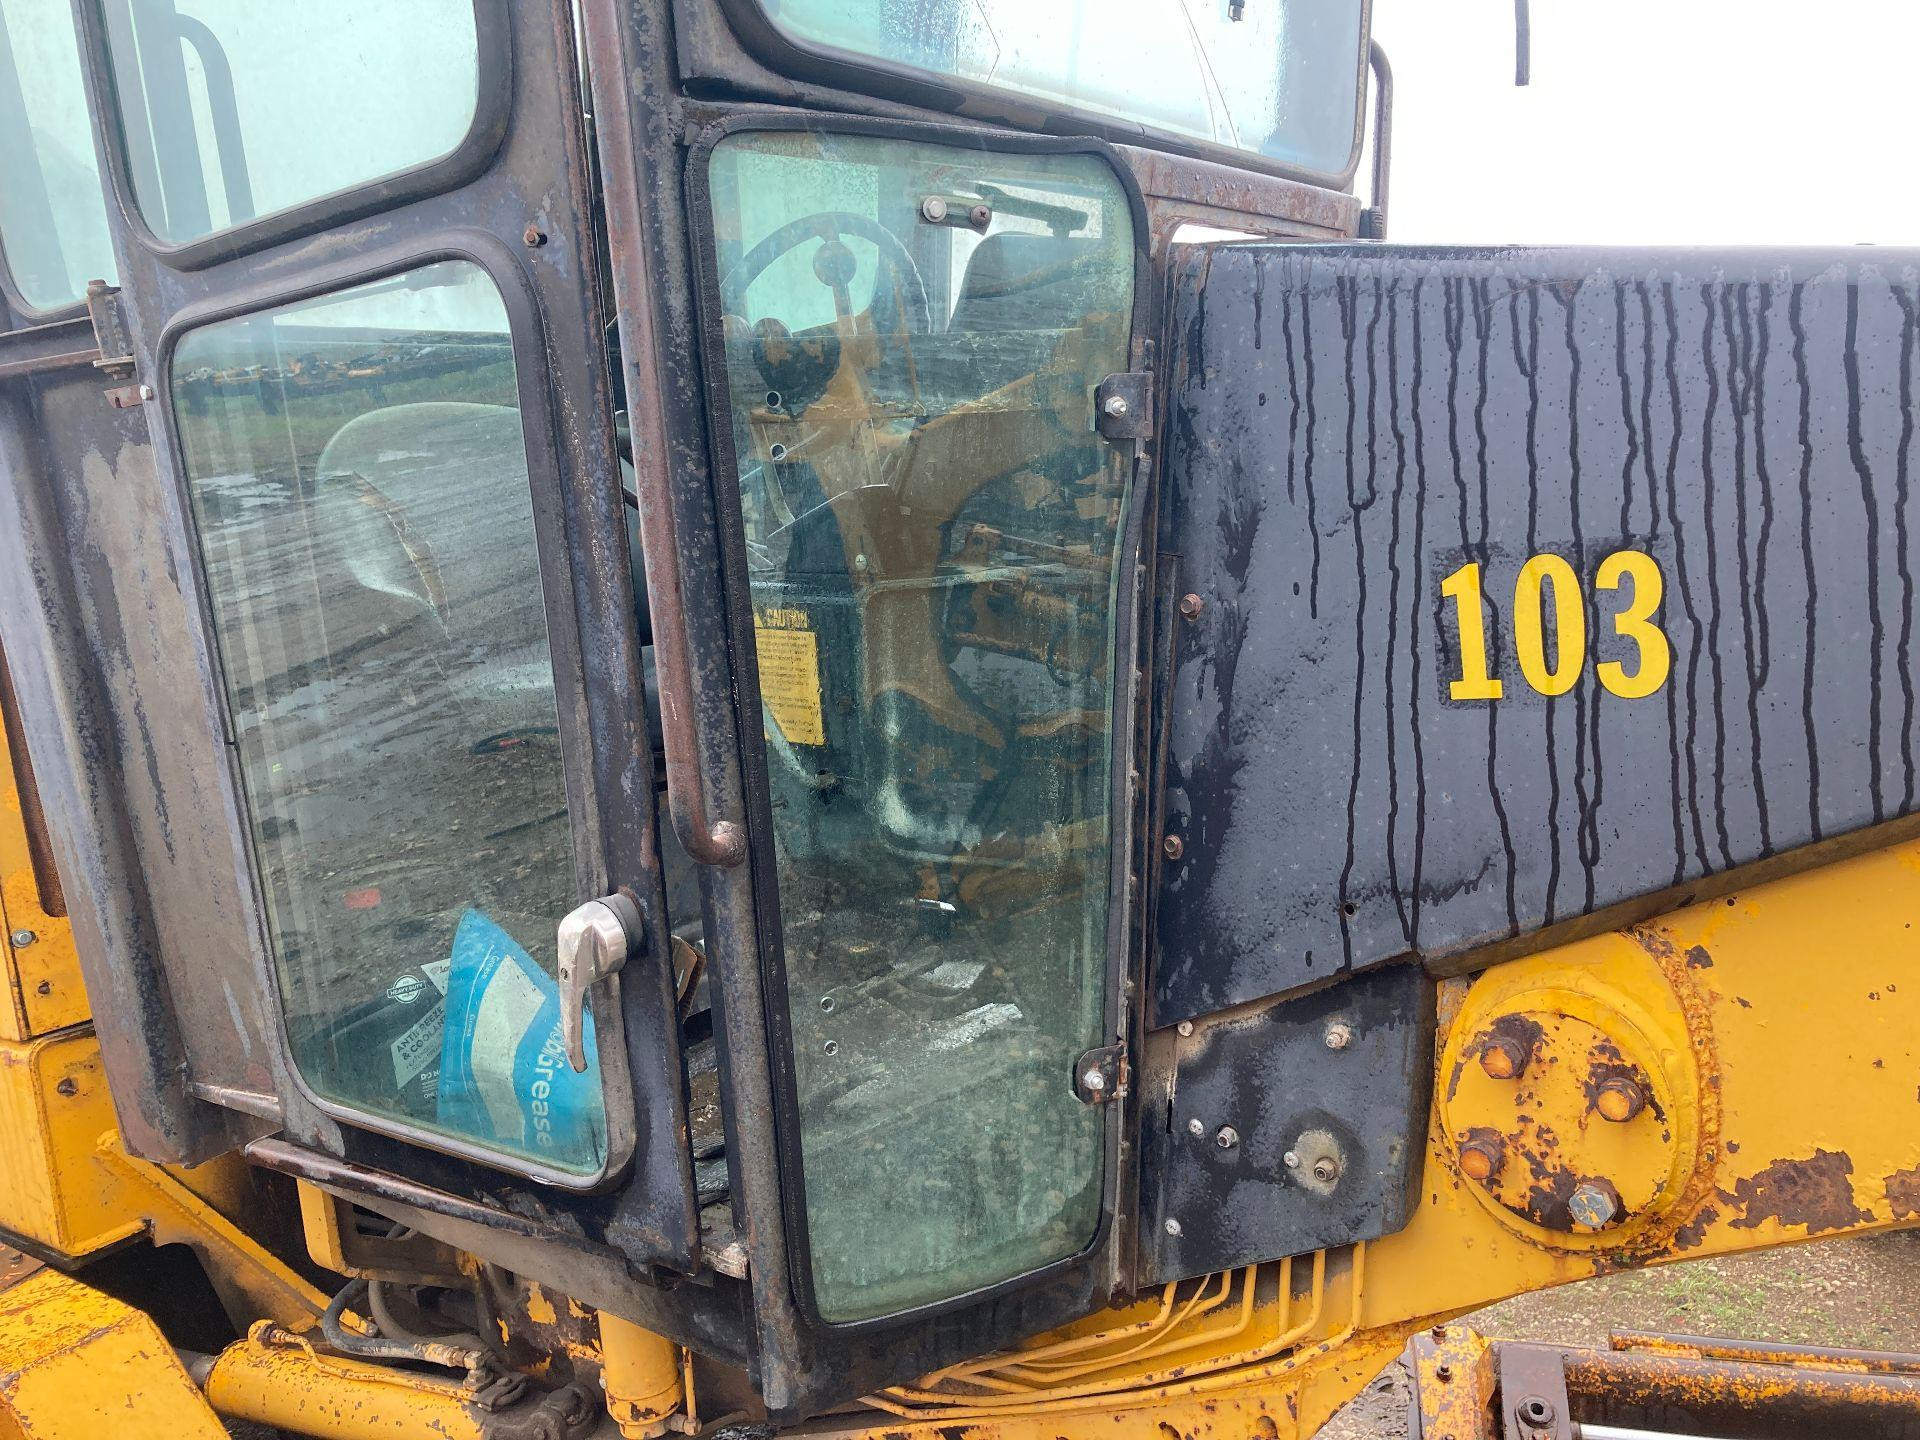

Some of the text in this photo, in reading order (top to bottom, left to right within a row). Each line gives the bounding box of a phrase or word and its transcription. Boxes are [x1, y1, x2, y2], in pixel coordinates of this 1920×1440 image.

[1441, 550, 1670, 700] 103
[389, 984, 409, 996] HEAVY
[402, 1052, 411, 1061] &
